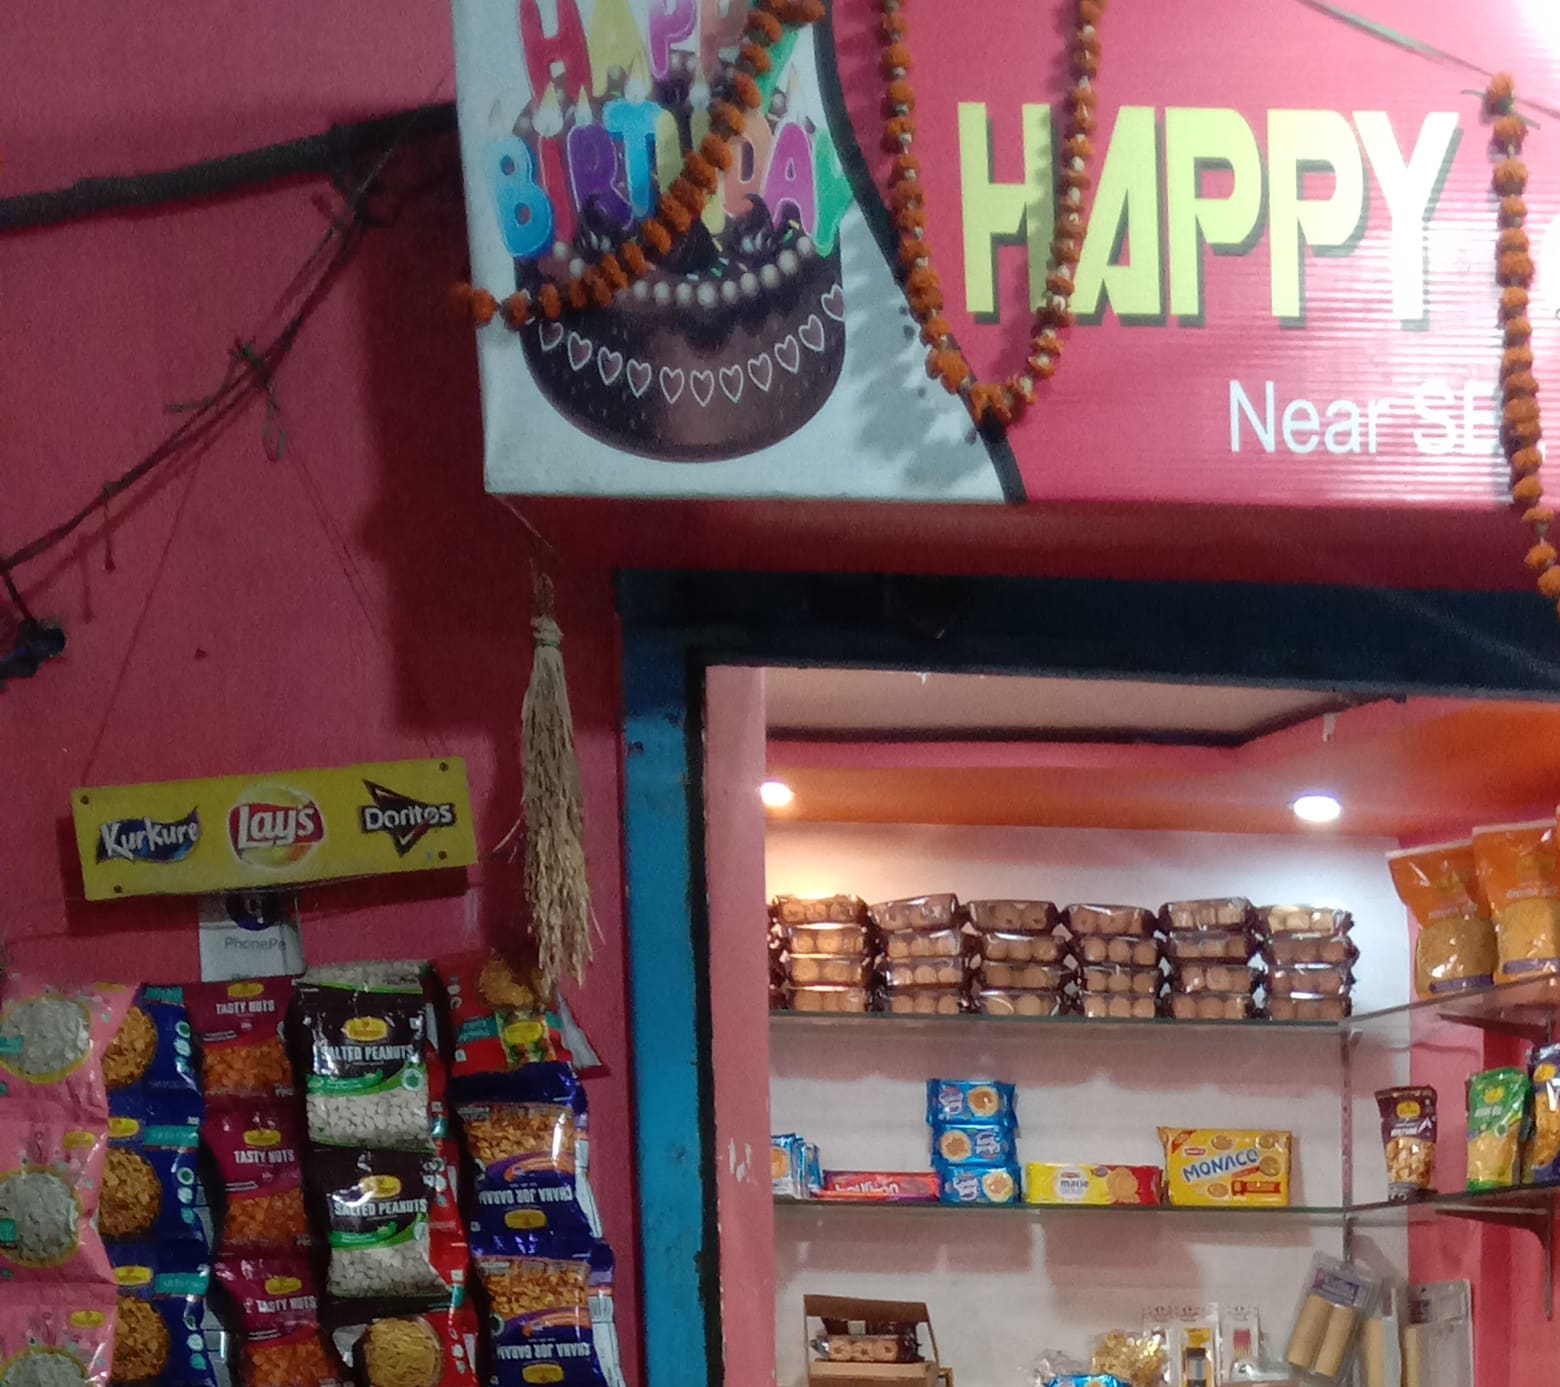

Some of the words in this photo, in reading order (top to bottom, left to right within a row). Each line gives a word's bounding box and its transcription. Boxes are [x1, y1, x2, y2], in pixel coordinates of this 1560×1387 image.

[957, 102, 1462, 322] HAPPY
[1229, 380, 1380, 454] Near
[363, 803, 454, 831] Doritos
[100, 816, 198, 861] Kurkure
[224, 936, 287, 952] PhonePe
[216, 1001, 247, 1014] TASTY
[249, 999, 275, 1012] NUTS
[364, 1044, 415, 1061] PEANUTS
[234, 1150, 266, 1164] TASTY
[268, 1148, 295, 1163] NUTS
[1183, 1146, 1259, 1182] MONACO
[333, 1200, 376, 1217] SALTED
[378, 1198, 428, 1215] PEANUTS
[256, 1298, 287, 1313] TASTY
[290, 1296, 317, 1309] NUTS
